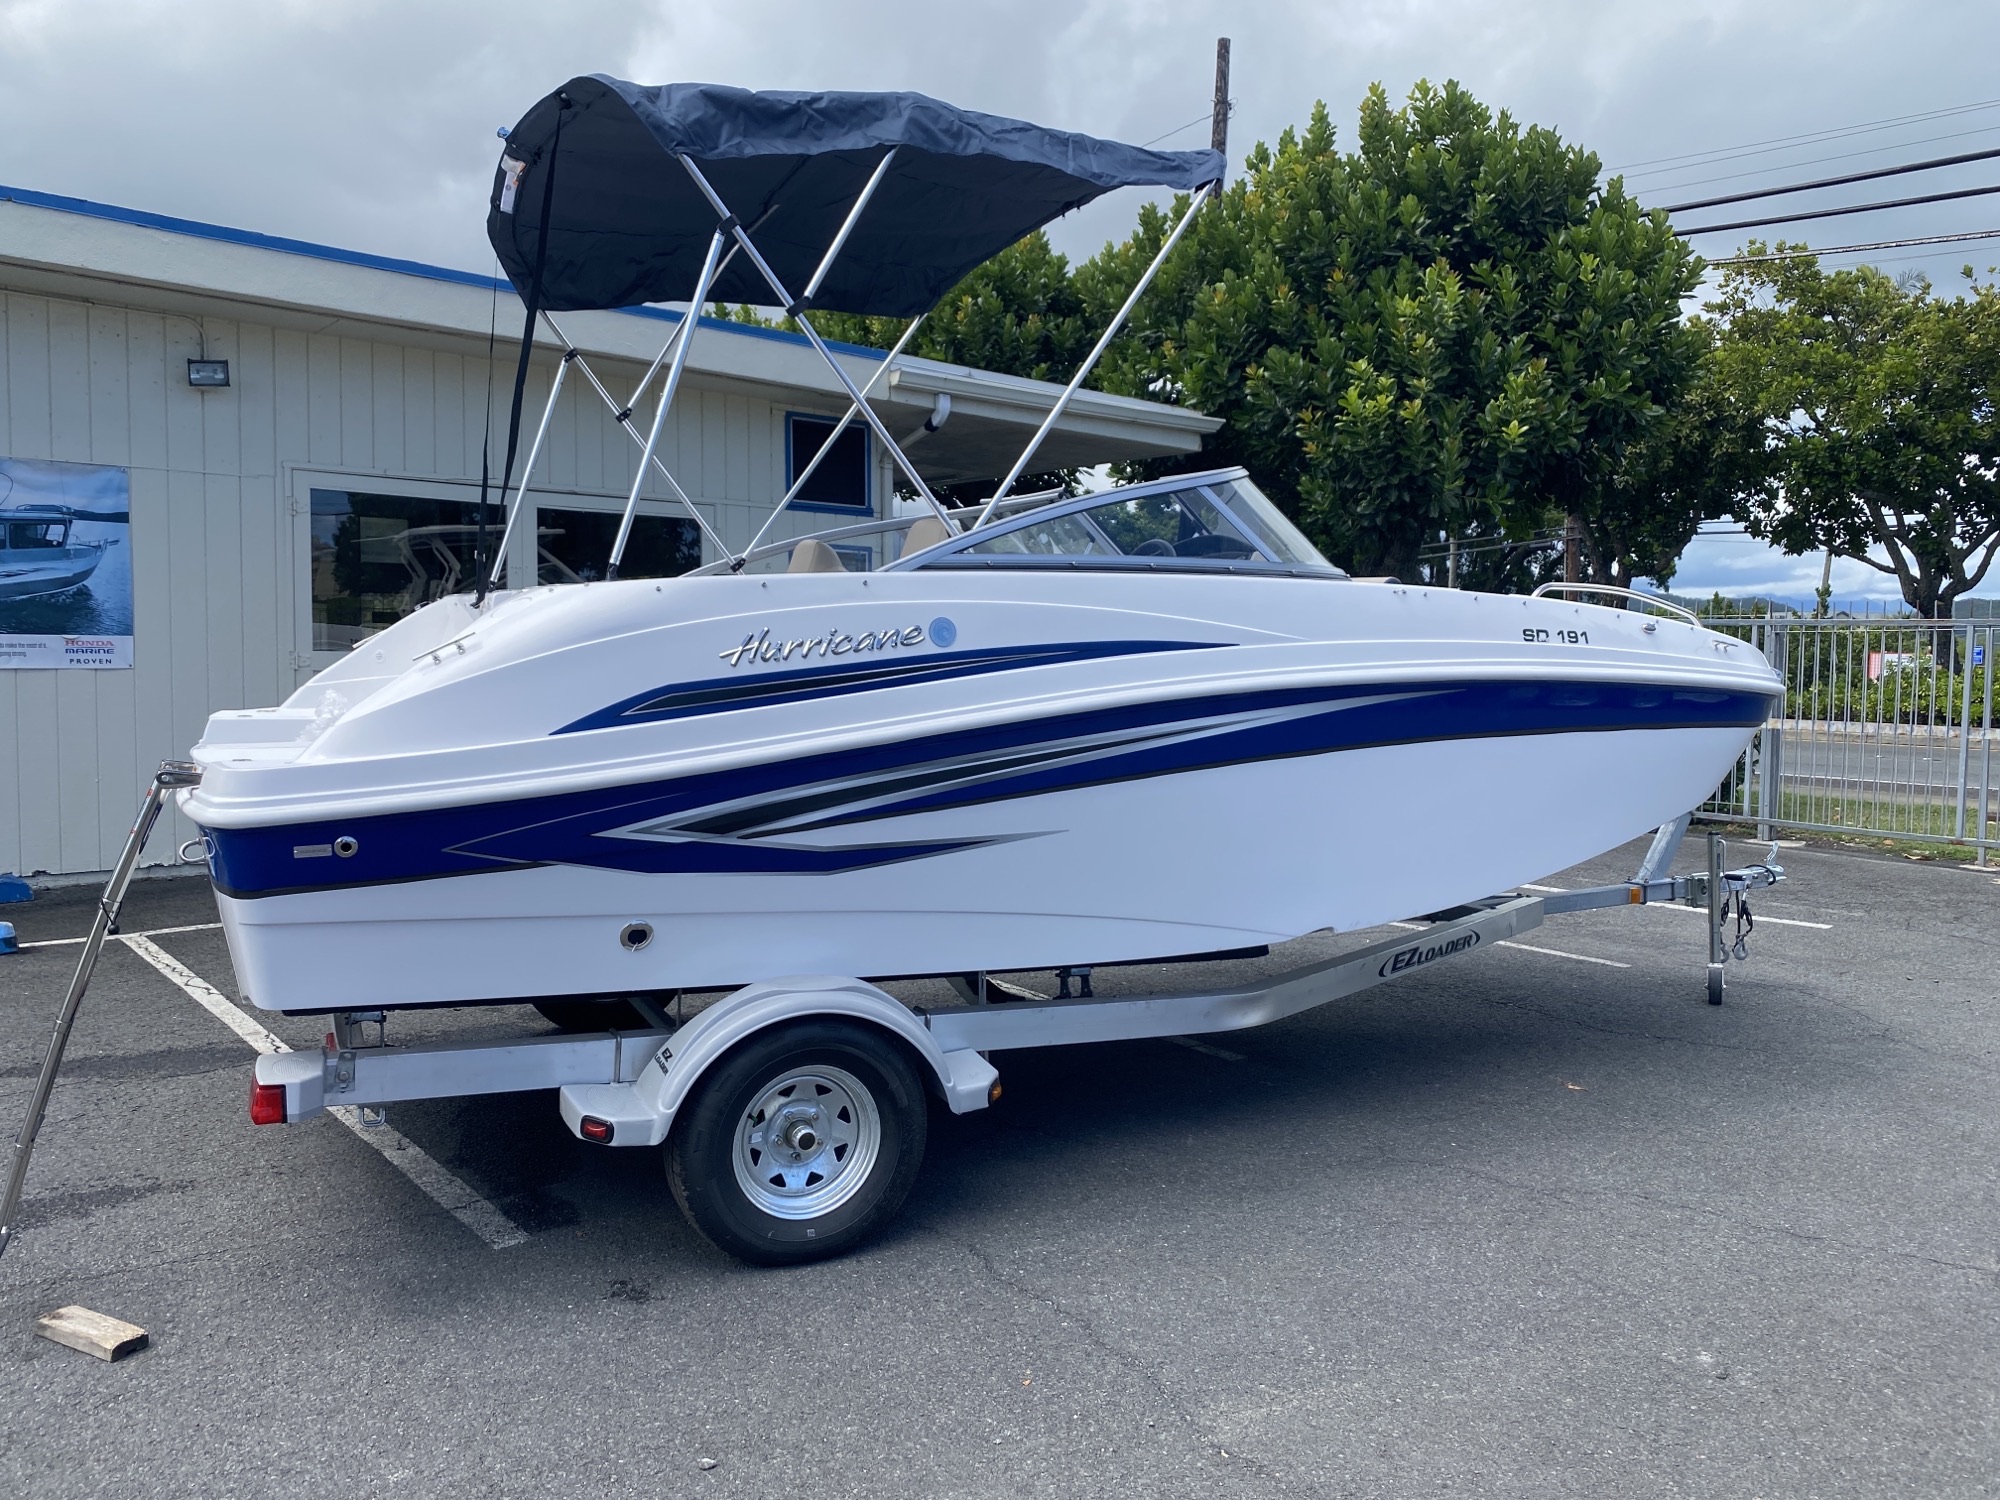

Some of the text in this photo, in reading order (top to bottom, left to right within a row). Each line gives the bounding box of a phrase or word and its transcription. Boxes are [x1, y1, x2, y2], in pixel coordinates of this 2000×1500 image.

[1522, 628, 1589, 645] SD 191
[719, 626, 926, 668] Hurricane
[661, 1046, 674, 1063] EZ
[654, 1053, 670, 1077] LOADER
